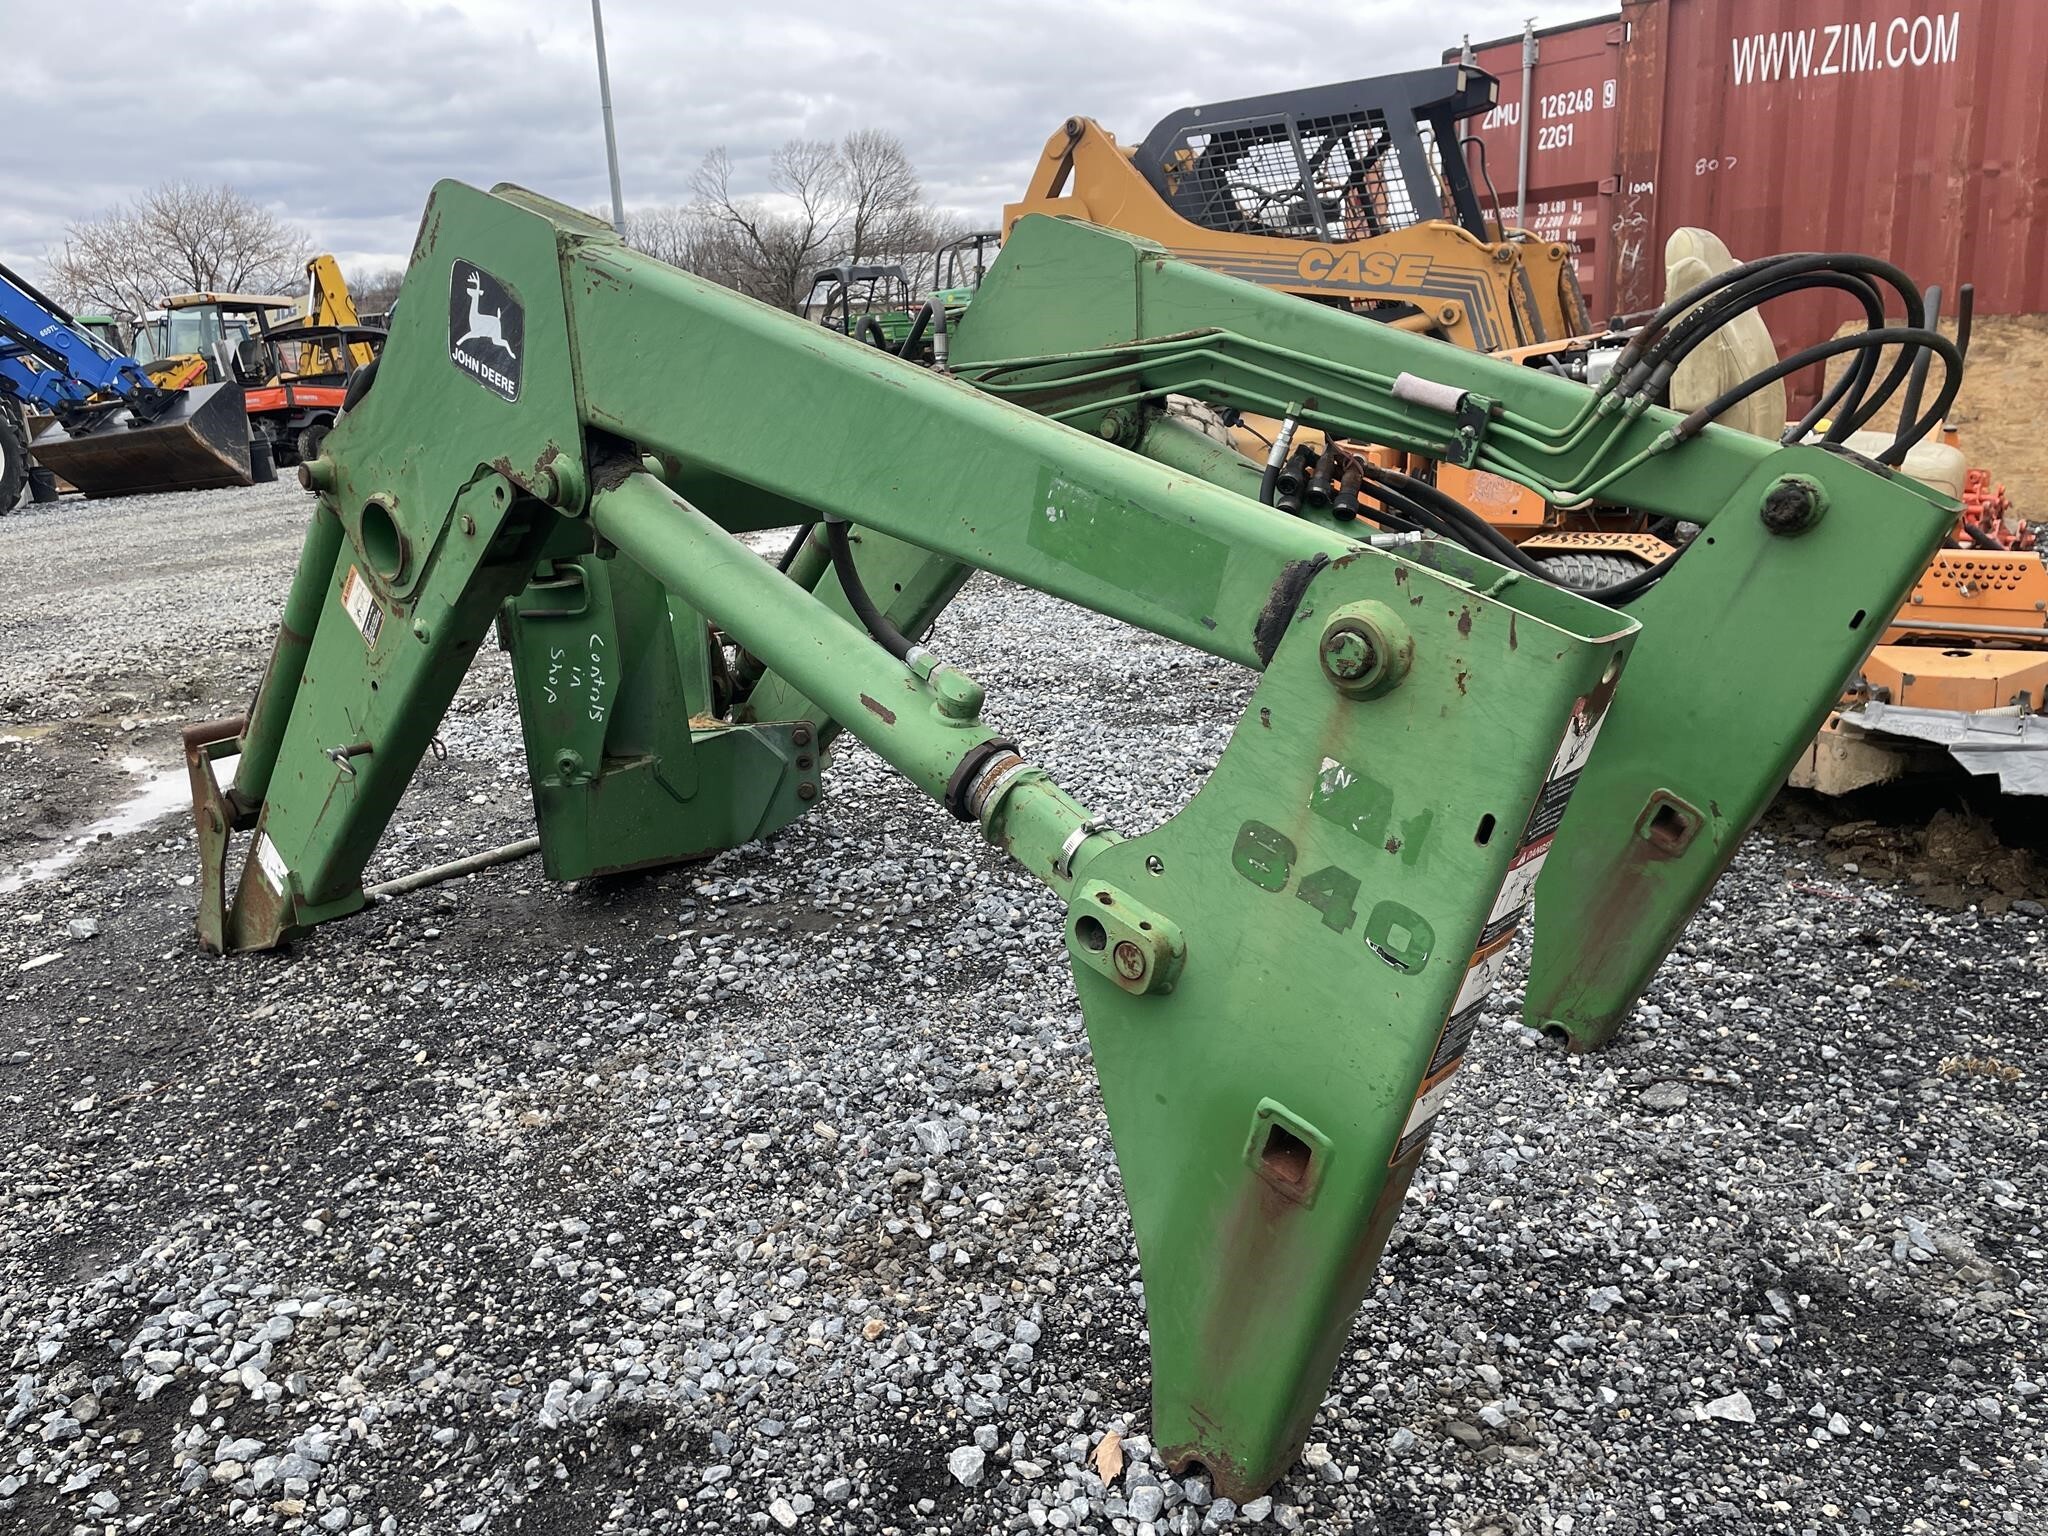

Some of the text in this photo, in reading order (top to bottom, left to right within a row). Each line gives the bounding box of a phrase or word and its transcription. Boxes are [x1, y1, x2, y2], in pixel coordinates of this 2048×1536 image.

[1732, 11, 1960, 86] WWW.ZIM.COM
[1482, 80, 1616, 130] ZIMU 126248 9
[1538, 123, 1574, 150] 22G1
[1573, 200, 1583, 214] kg
[1628, 181, 1653, 195] 1009
[1567, 228, 1577, 242] kg
[1297, 247, 1434, 287] CASE
[452, 347, 516, 396] JOHN DEERE
[543, 647, 566, 704] Shop
[570, 666, 586, 688] in
[589, 634, 606, 722] Controls
[1232, 819, 1436, 977] 640
